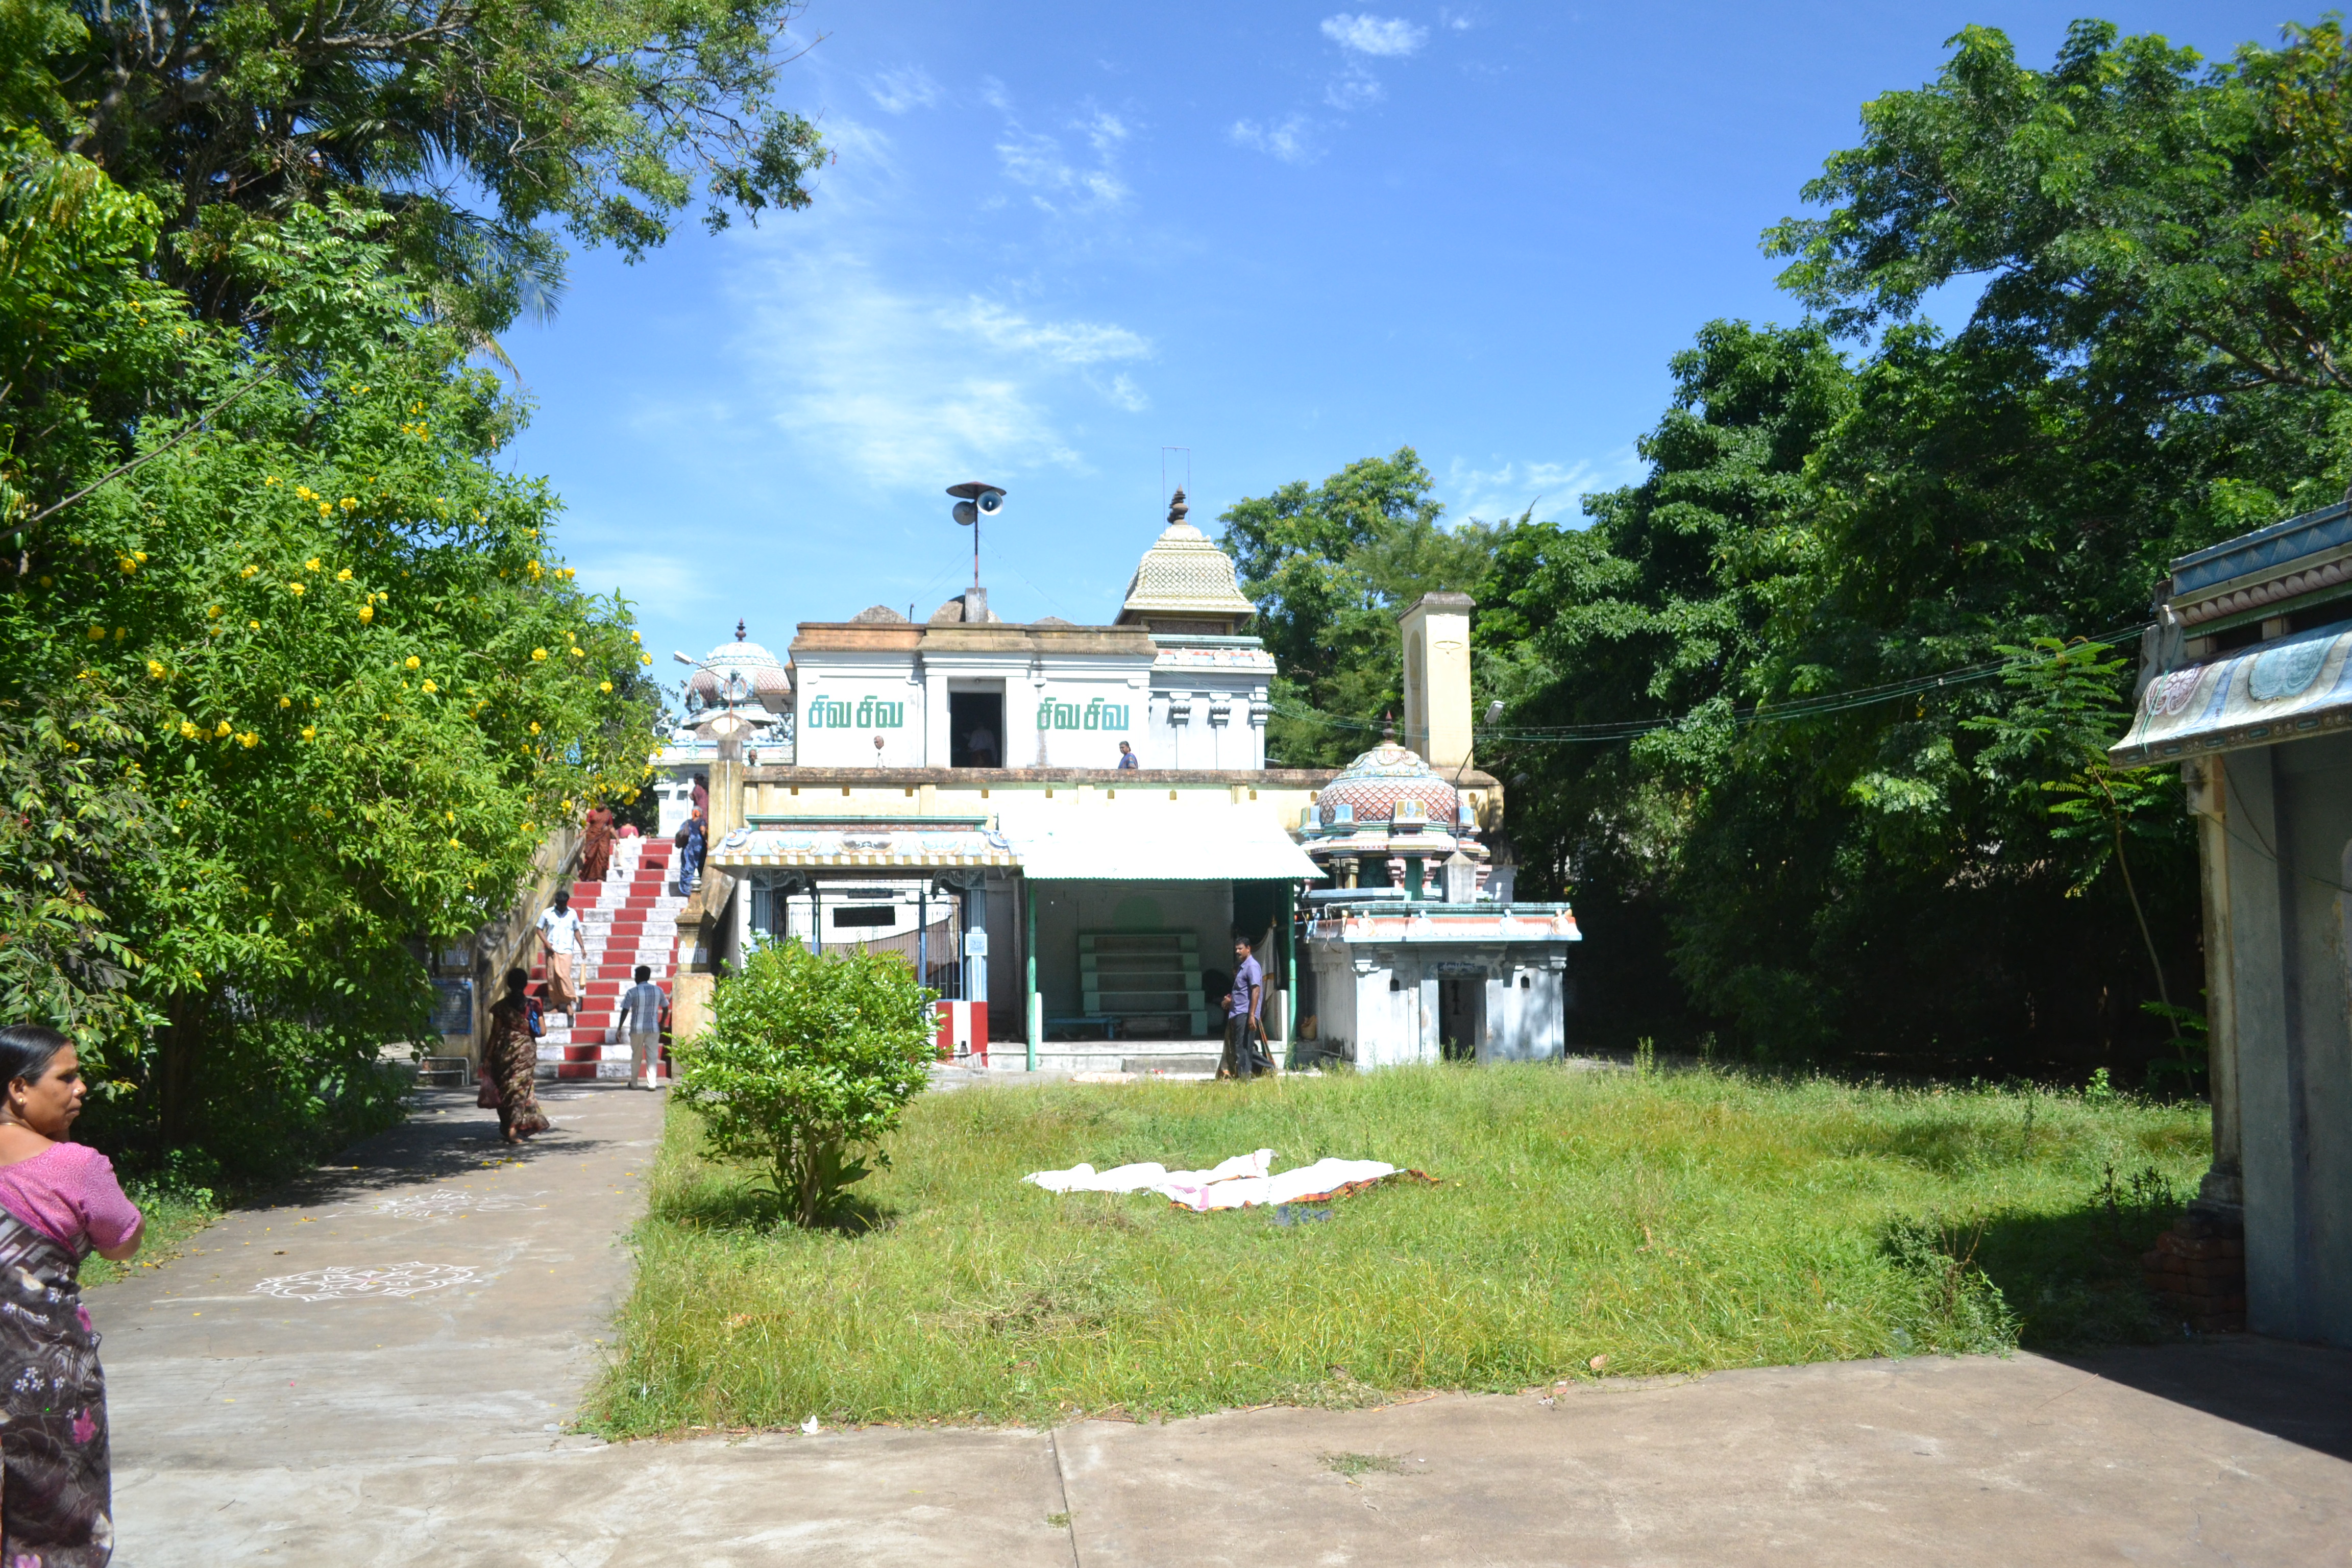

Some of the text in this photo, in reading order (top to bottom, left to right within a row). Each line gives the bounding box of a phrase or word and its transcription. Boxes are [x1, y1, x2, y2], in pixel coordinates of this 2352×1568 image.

[808, 695, 903, 728] சிவ சிவ
[1037, 697, 1129, 731] சிவ சிவ
